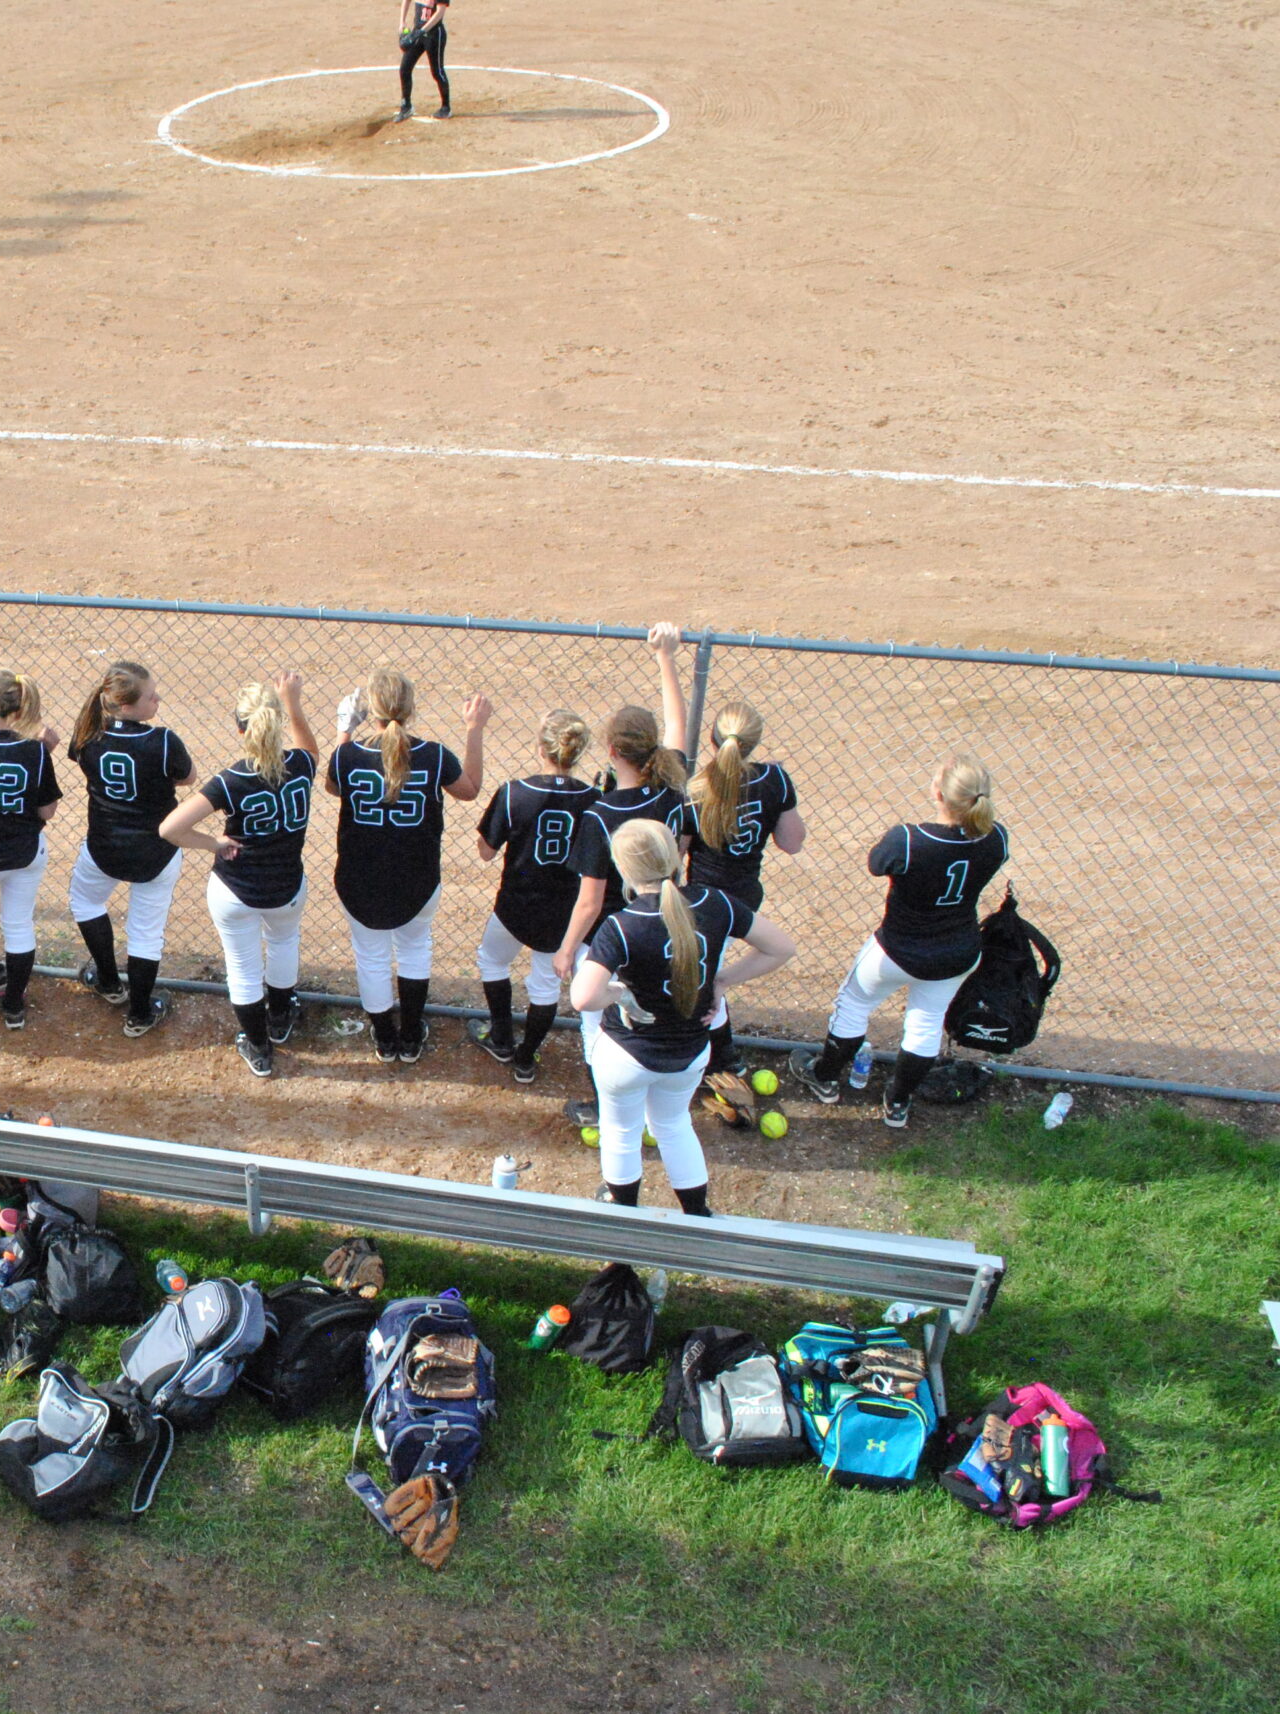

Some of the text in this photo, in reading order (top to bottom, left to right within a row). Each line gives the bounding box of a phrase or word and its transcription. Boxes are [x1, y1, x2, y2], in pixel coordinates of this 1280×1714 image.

[100, 752, 137, 801] 9
[348, 769, 428, 827] 25
[240, 776, 311, 836] 20
[728, 800, 762, 856] 5
[534, 809, 574, 866] 8
[936, 860, 970, 906] 1
